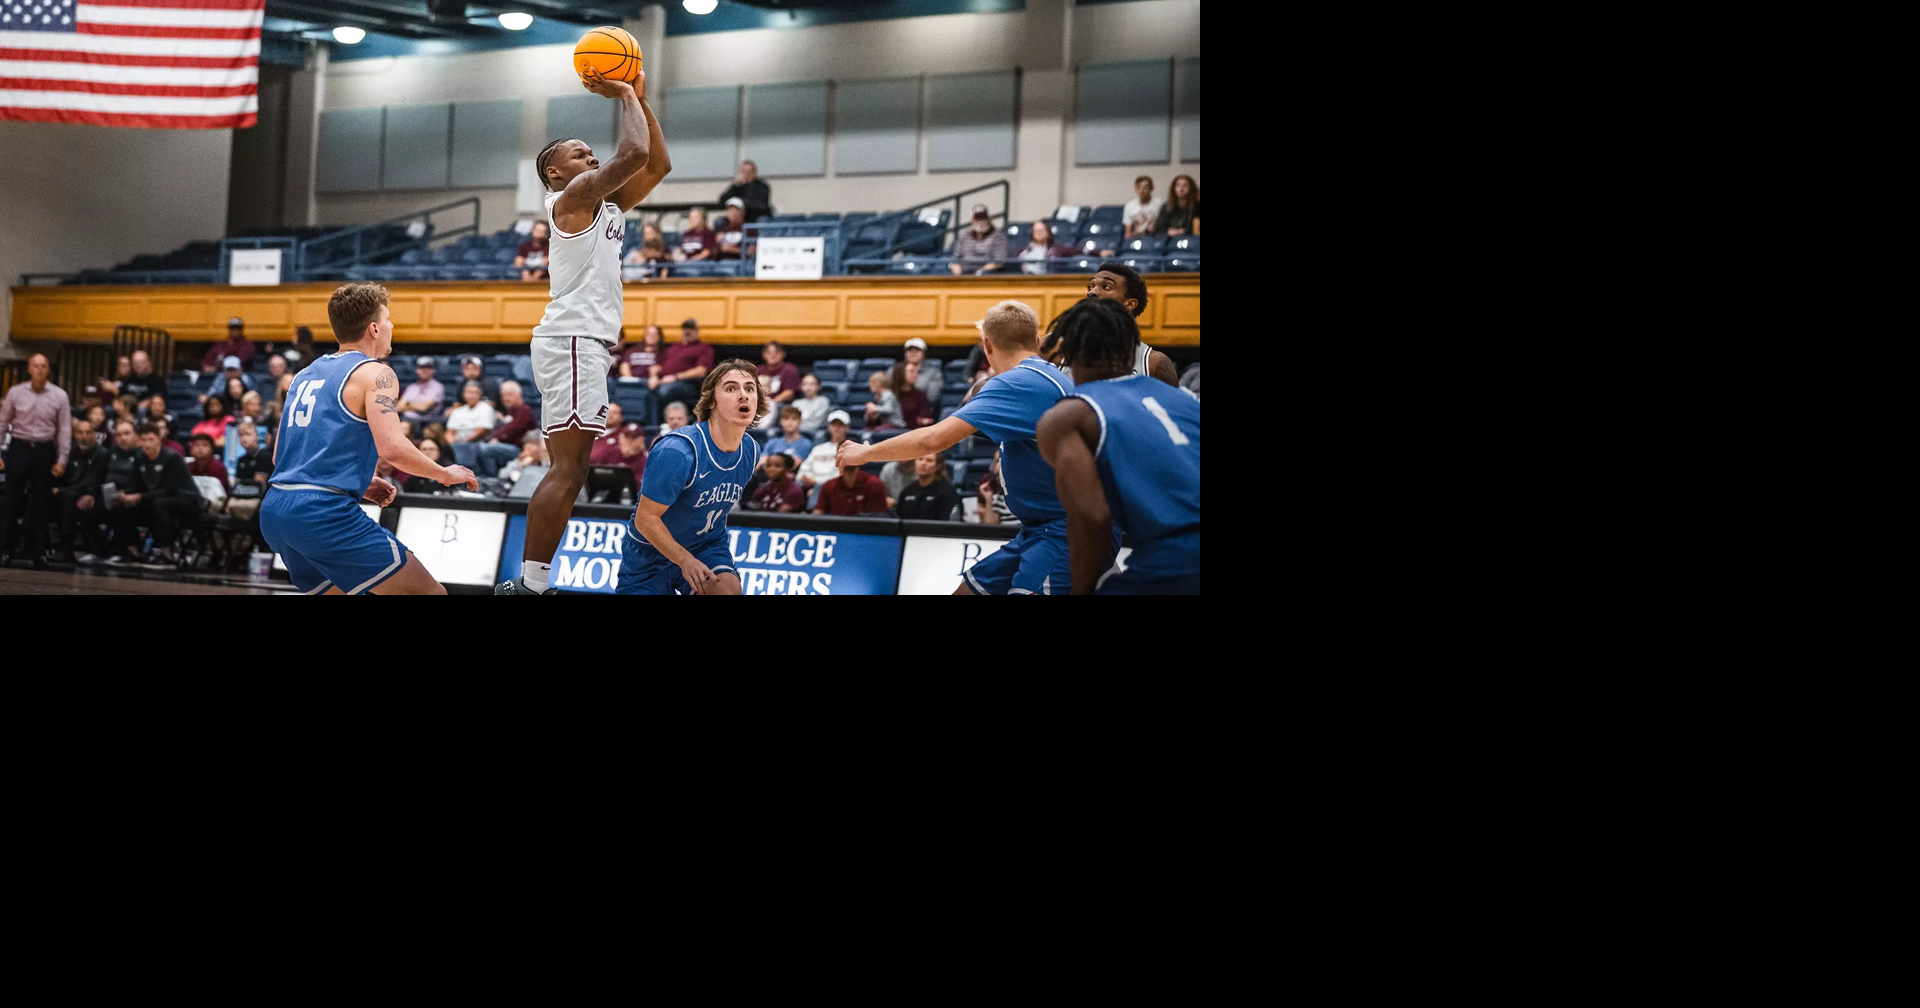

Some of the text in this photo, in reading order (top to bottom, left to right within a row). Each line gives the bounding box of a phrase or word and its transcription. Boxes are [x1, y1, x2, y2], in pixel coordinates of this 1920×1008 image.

[287, 378, 326, 428] 15
[1141, 396, 1190, 446] 1
[439, 512, 459, 544] B
[696, 509, 723, 536] 11
